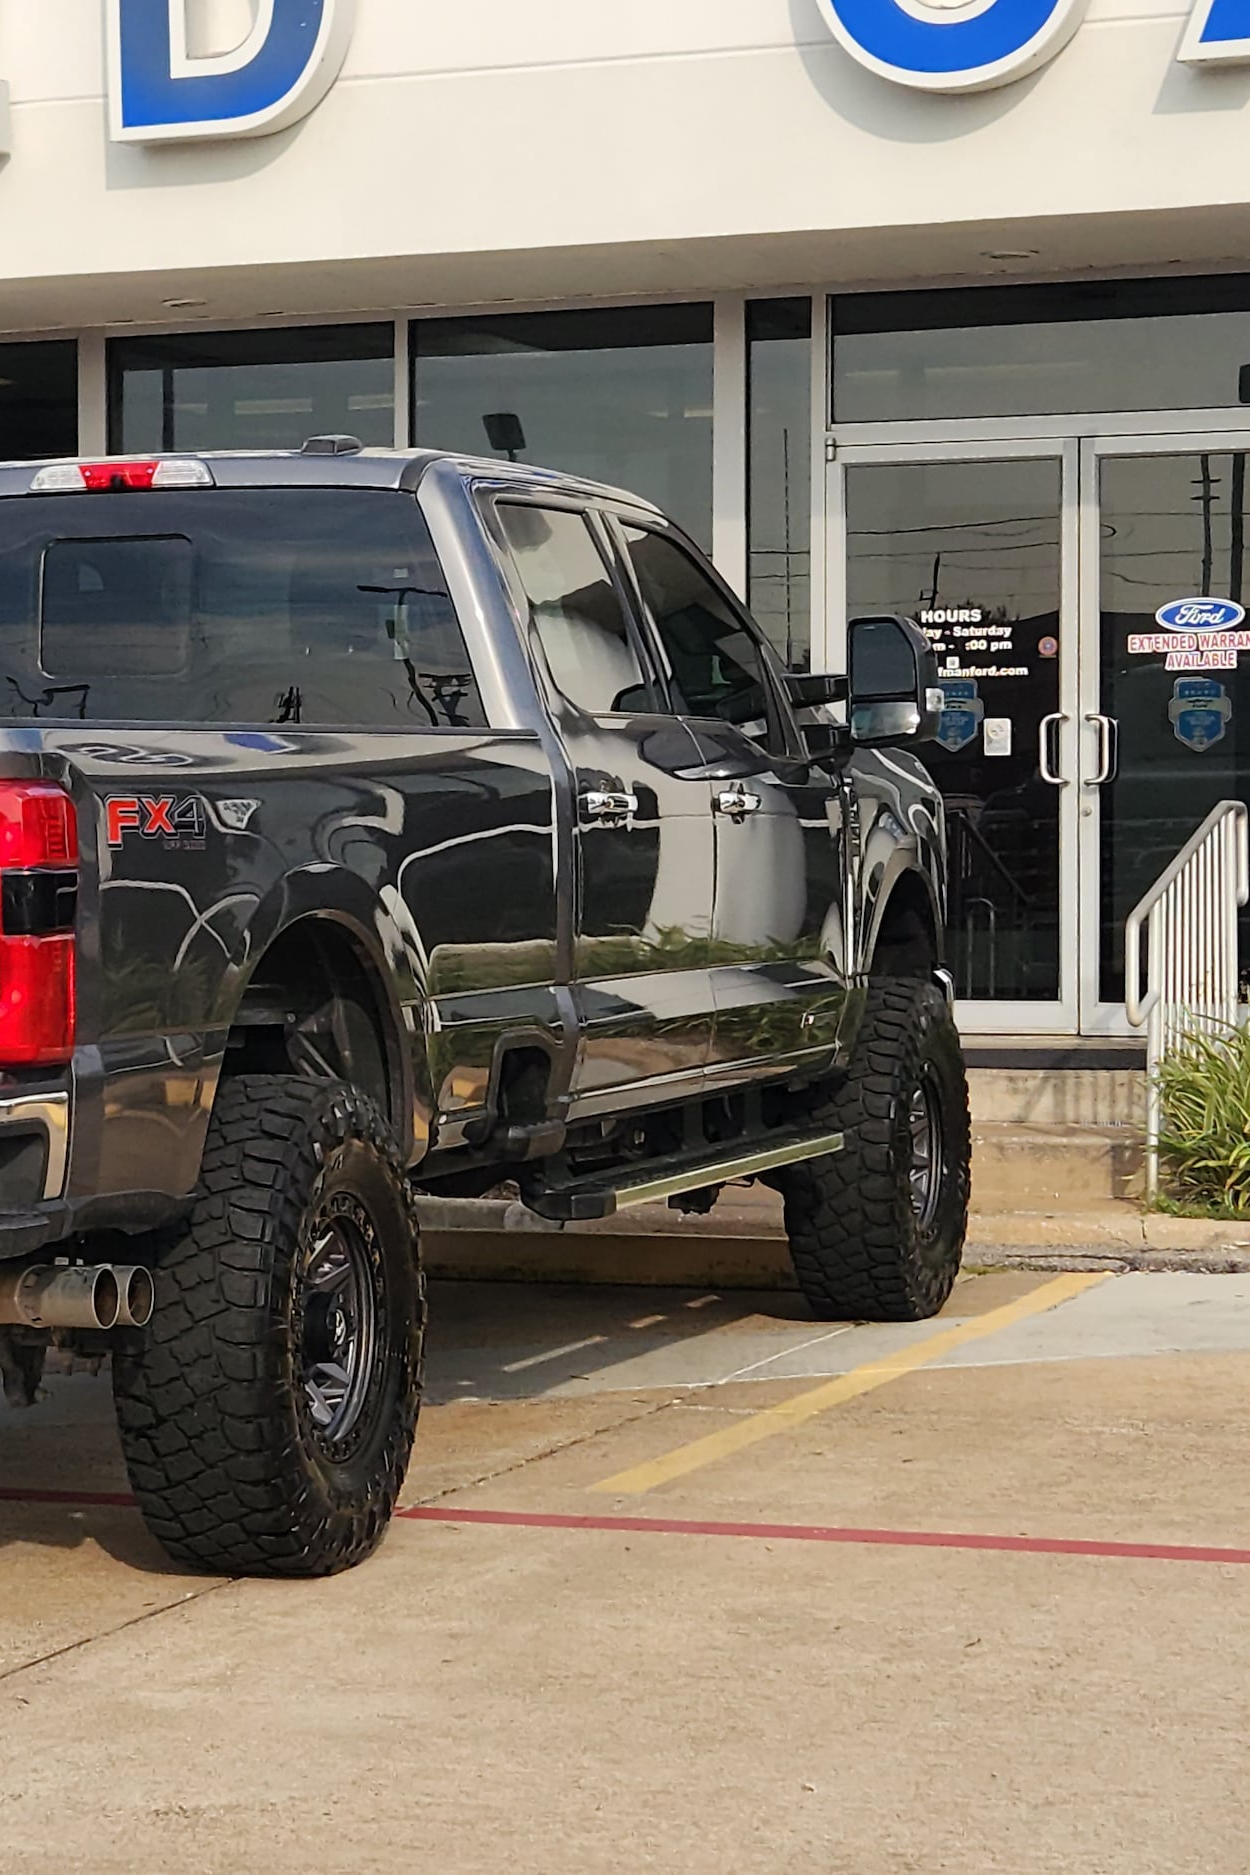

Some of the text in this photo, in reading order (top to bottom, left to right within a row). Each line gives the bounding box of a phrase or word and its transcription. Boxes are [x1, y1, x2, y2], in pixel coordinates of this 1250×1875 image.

[920, 609, 982, 623] HOURS
[1175, 604, 1226, 625] Ford
[952, 625, 1012, 638] Saturday
[990, 641, 1013, 652] pm
[1130, 635, 1196, 652] EXTENDED
[1168, 653, 1235, 668] AVAILABLE
[105, 795, 207, 850] FX4
